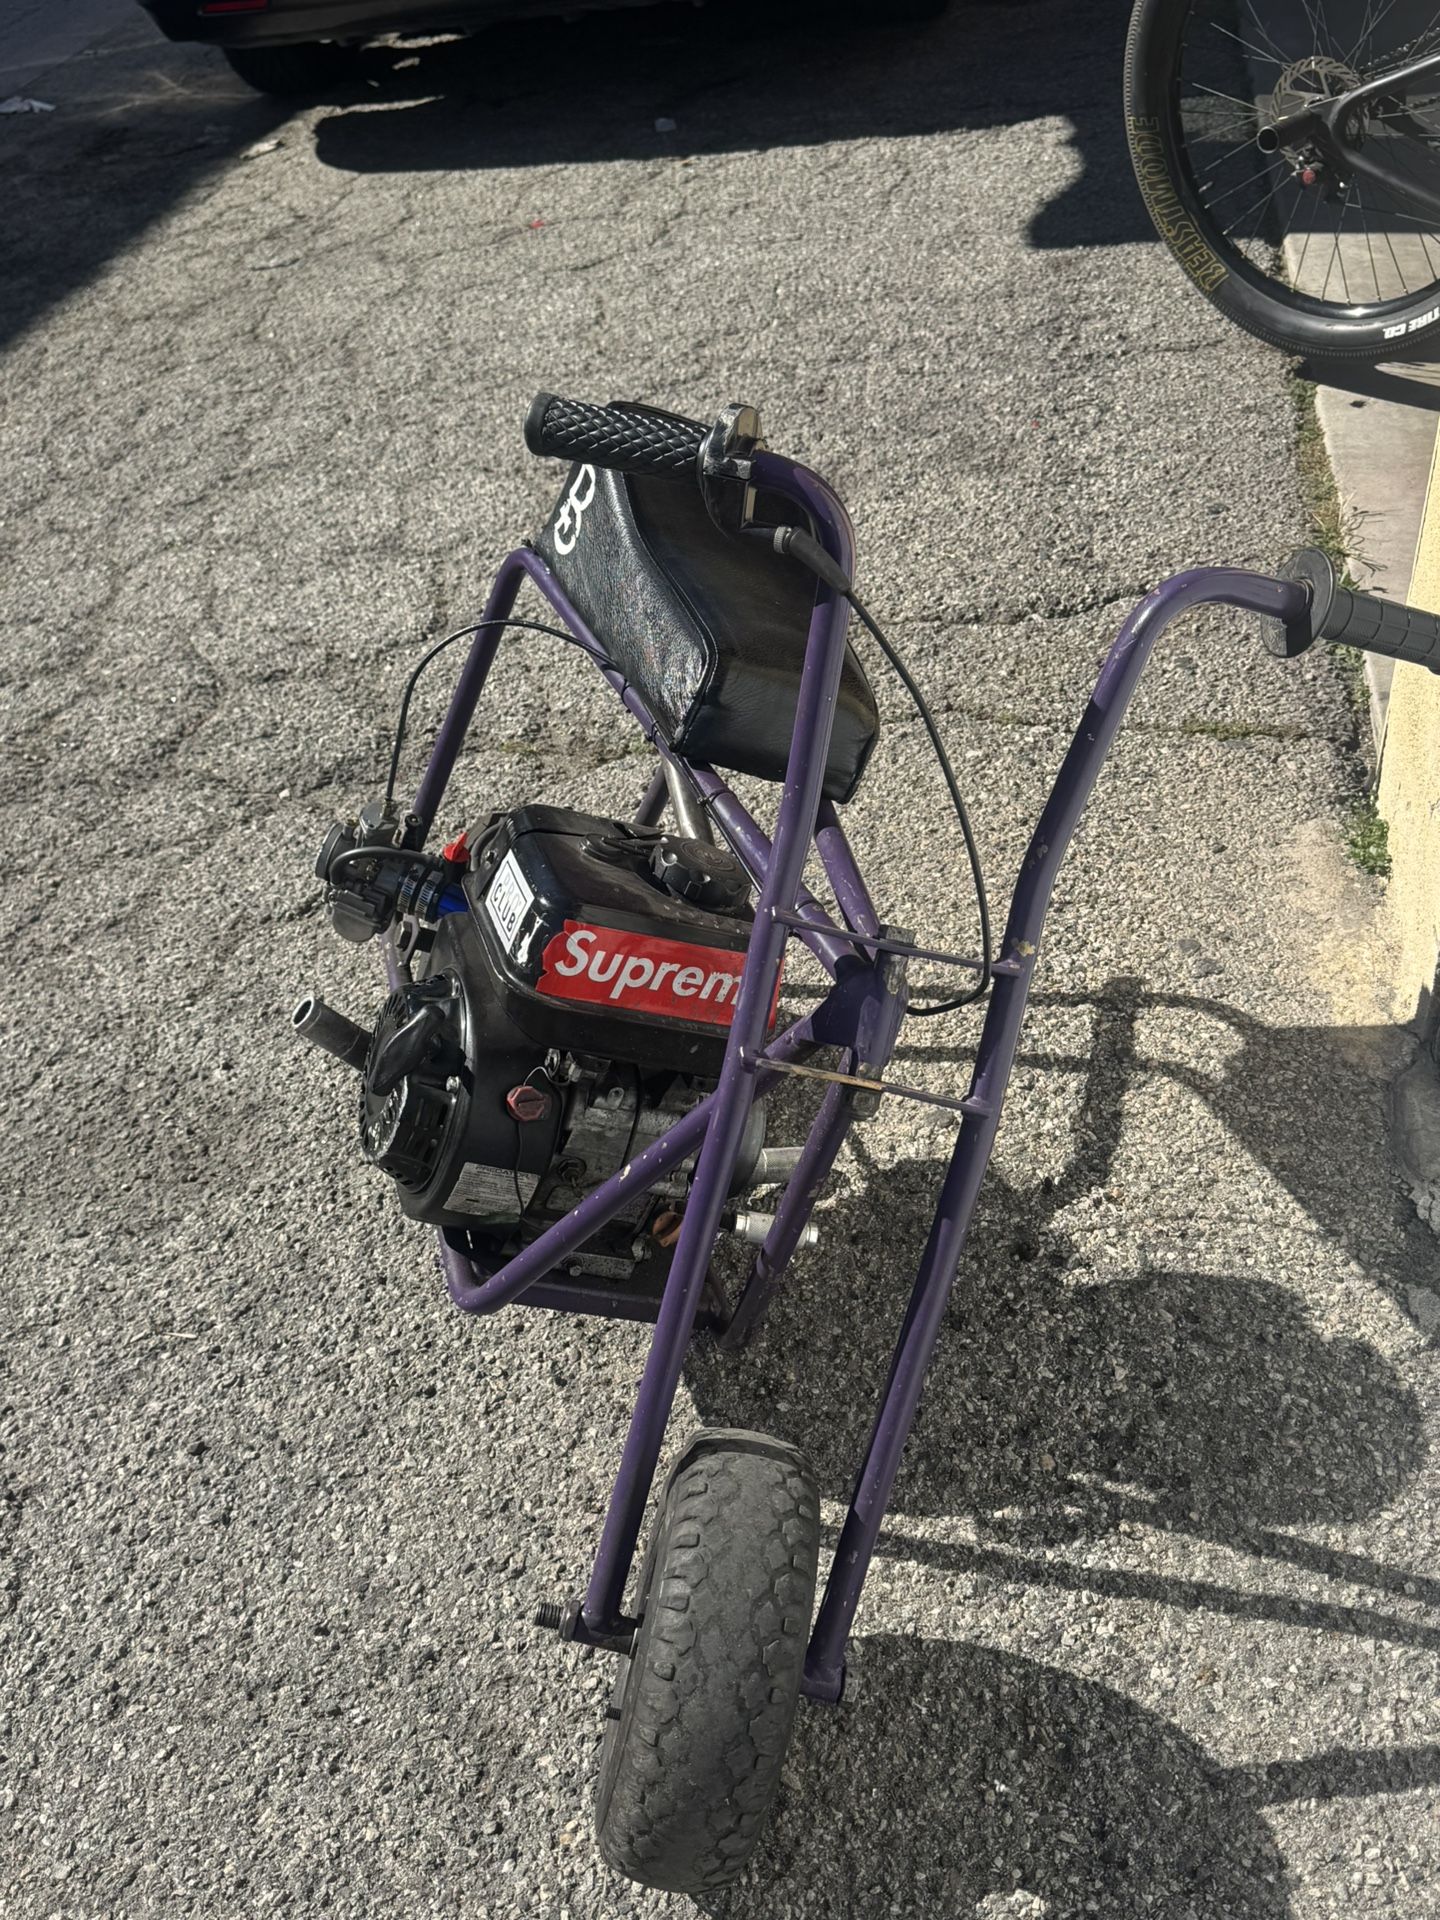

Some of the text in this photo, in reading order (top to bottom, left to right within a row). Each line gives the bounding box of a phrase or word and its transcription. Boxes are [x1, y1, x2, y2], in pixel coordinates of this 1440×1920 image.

[1132, 116, 1230, 292] BEASTMODE
[493, 882, 516, 933] CLUB
[554, 929, 743, 1005] Suprem
